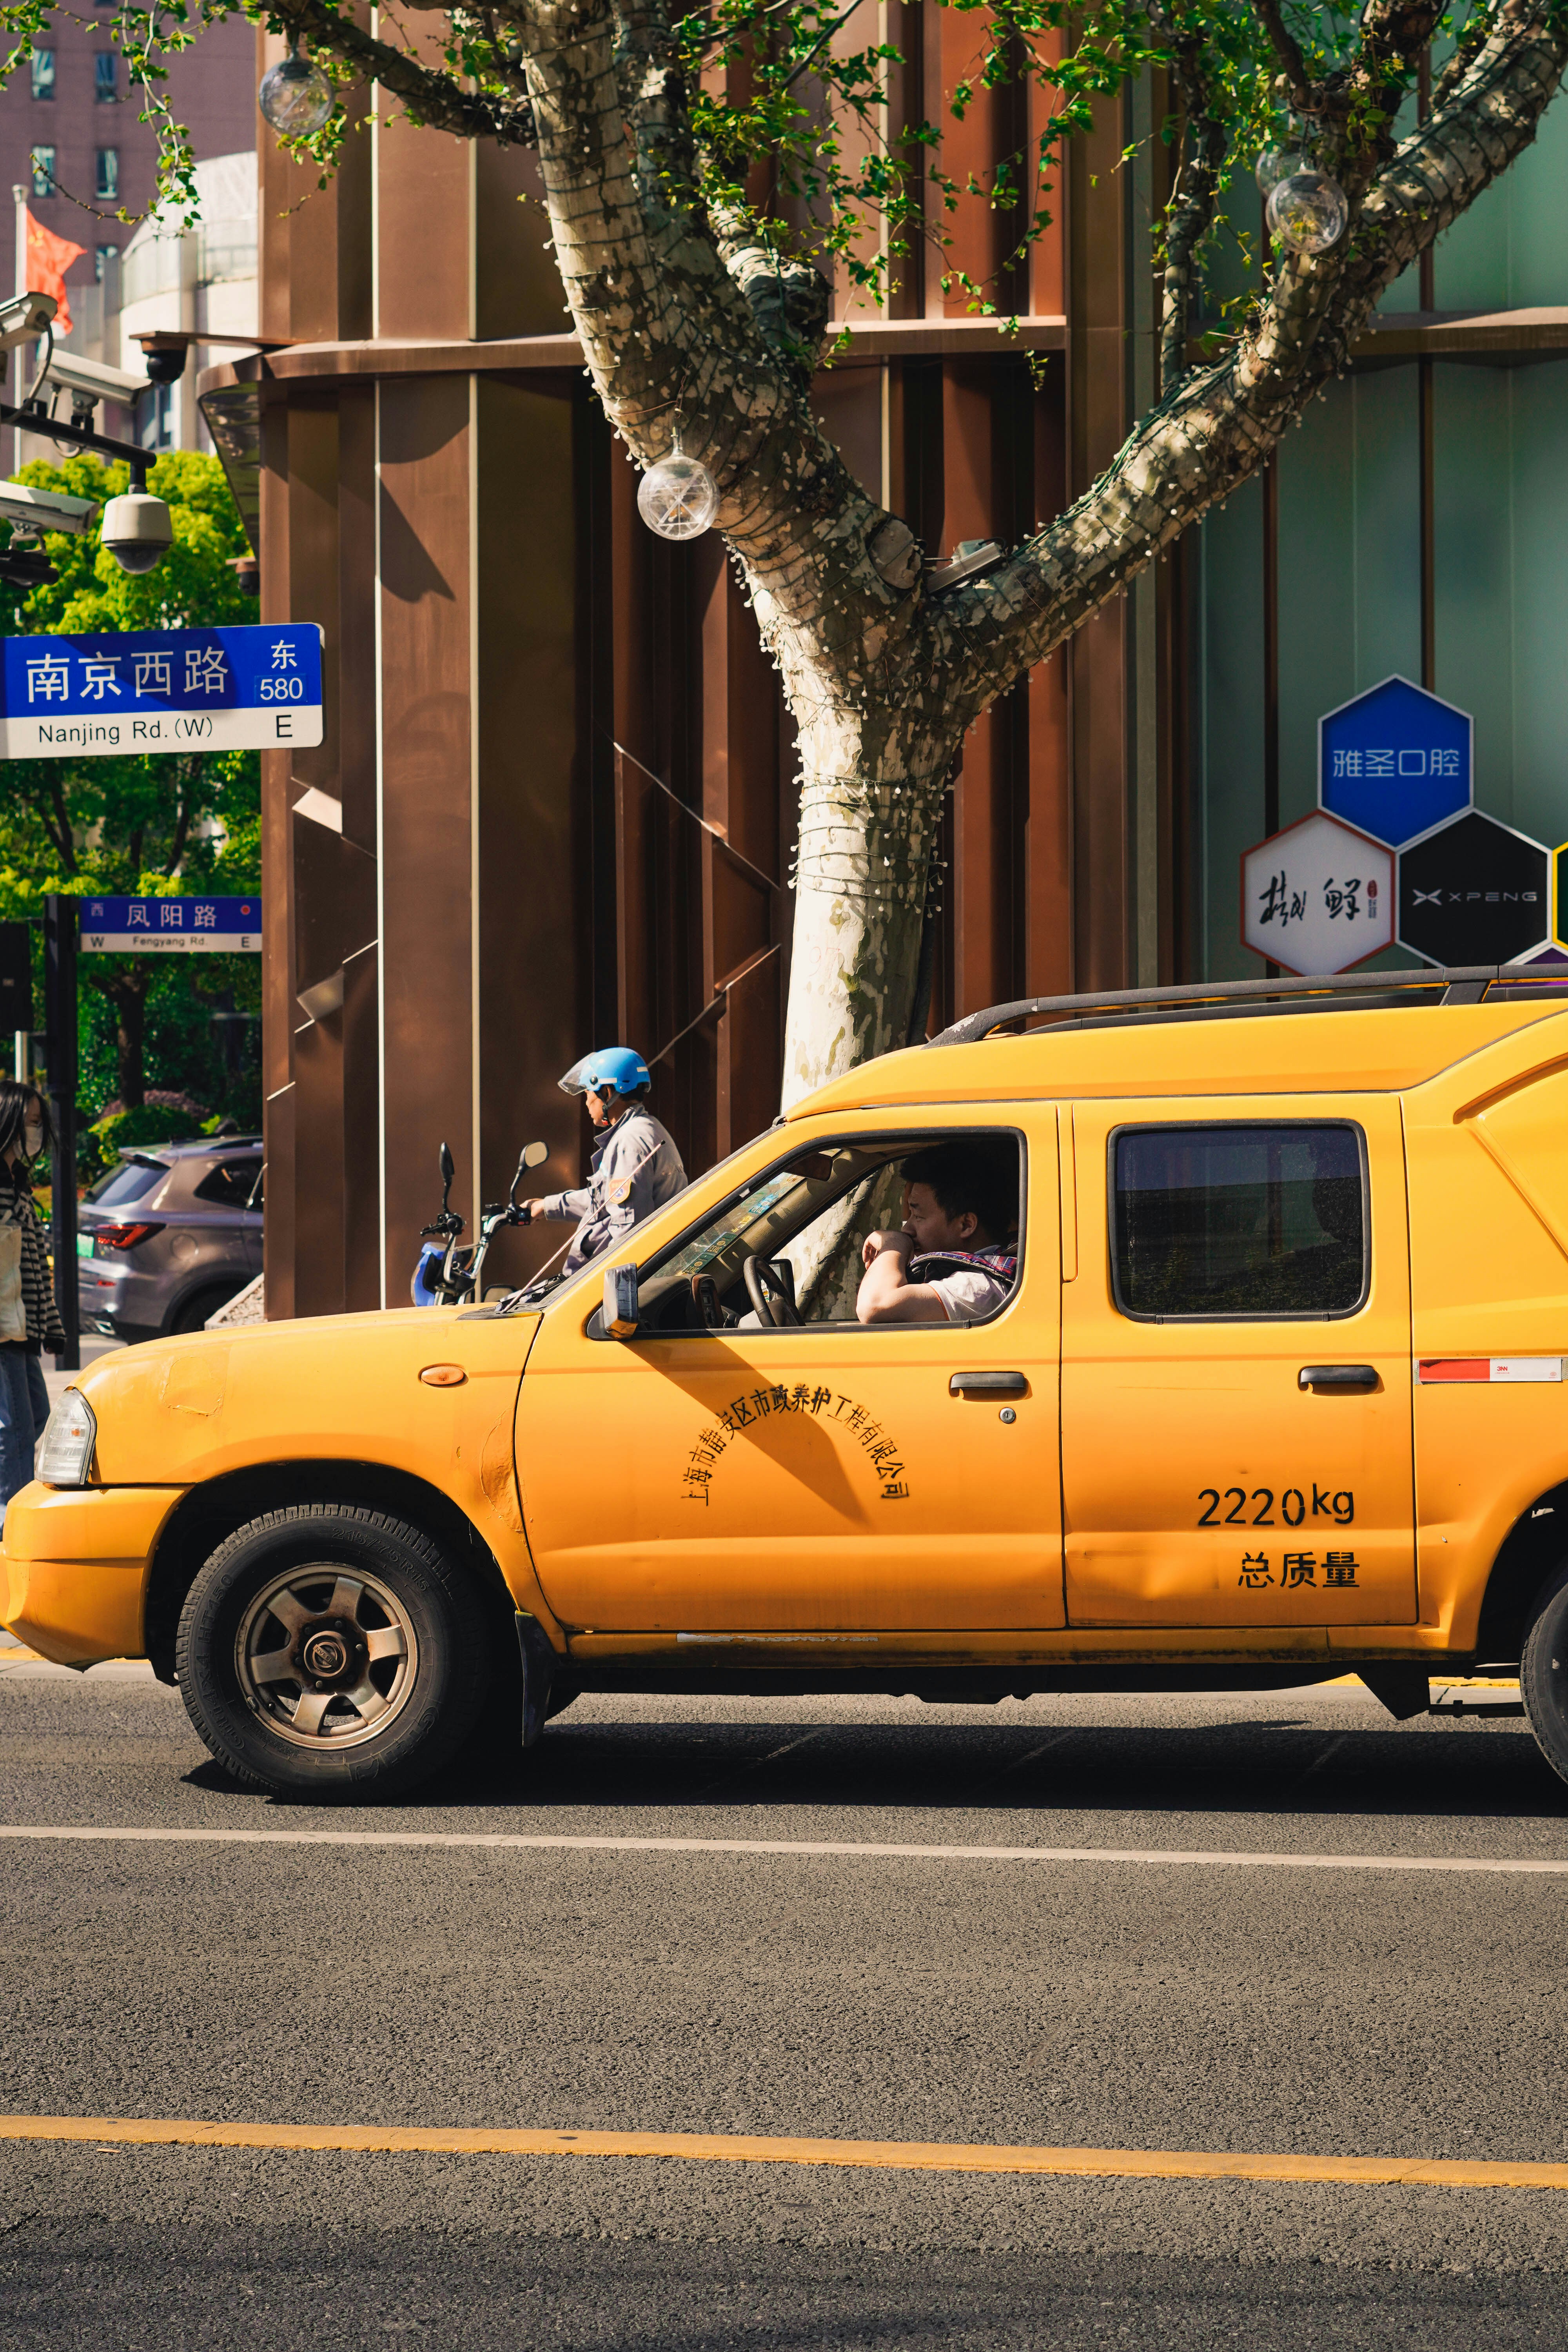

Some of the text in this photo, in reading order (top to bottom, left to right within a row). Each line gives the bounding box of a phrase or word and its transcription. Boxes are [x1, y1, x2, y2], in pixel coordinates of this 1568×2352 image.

[271, 639, 297, 670] 东
[26, 646, 229, 703] 南京西路
[260, 677, 303, 700] 580
[39, 724, 120, 746] Nanjing
[276, 715, 293, 738] E
[1333, 749, 1459, 777] 雅圣口腔
[1448, 891, 1537, 902] XPENG
[91, 903, 103, 916] 西
[127, 905, 217, 927] 凤阳路
[91, 936, 105, 948] W
[133, 936, 208, 947] Fengyang Rd.
[241, 936, 250, 948] E
[1198, 1483, 1354, 1526] 2220kg
[1238, 1551, 1360, 1588] 总质量
